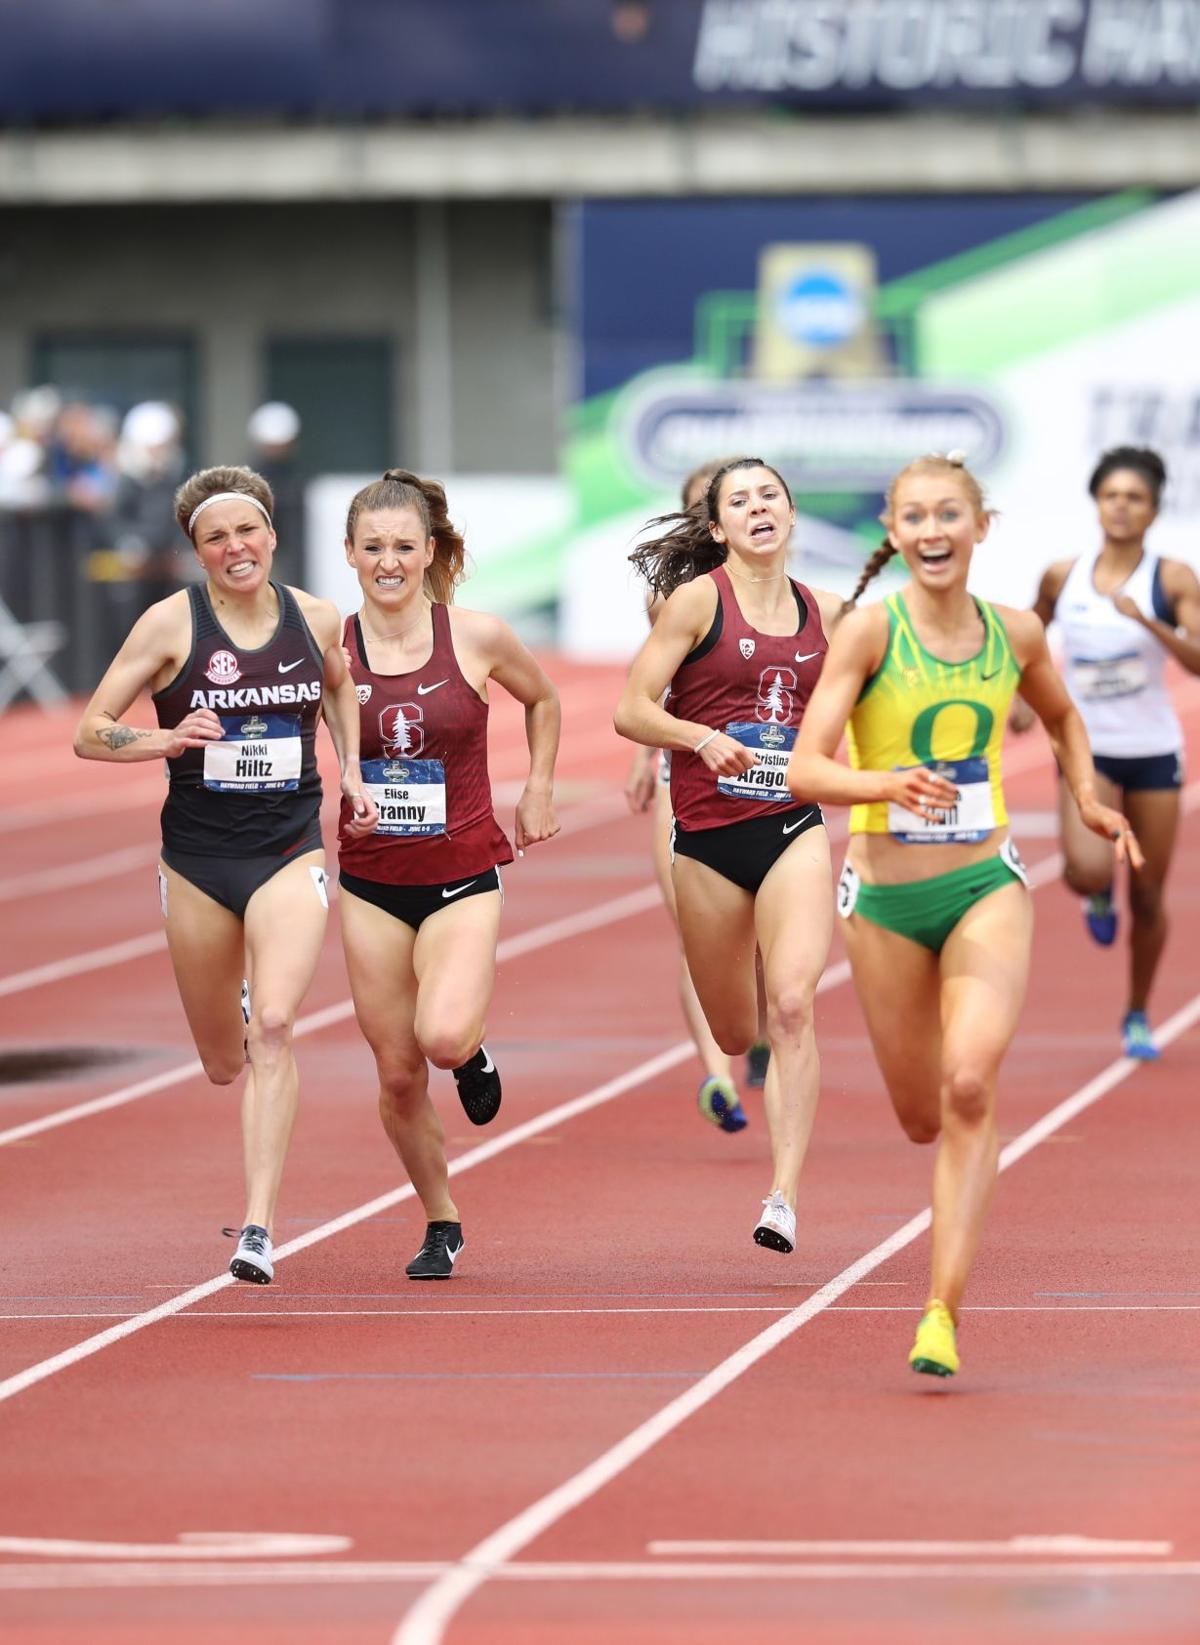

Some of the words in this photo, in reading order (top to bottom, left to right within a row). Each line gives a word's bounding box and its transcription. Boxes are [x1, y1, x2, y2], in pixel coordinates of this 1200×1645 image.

[212, 652, 234, 675] SEC
[190, 681, 321, 709] ARKANSAS
[910, 699, 994, 764] O
[241, 744, 268, 757] Nikki
[754, 752, 789, 767] hristina
[236, 759, 272, 777] Hiltz
[384, 788, 409, 800] Elise
